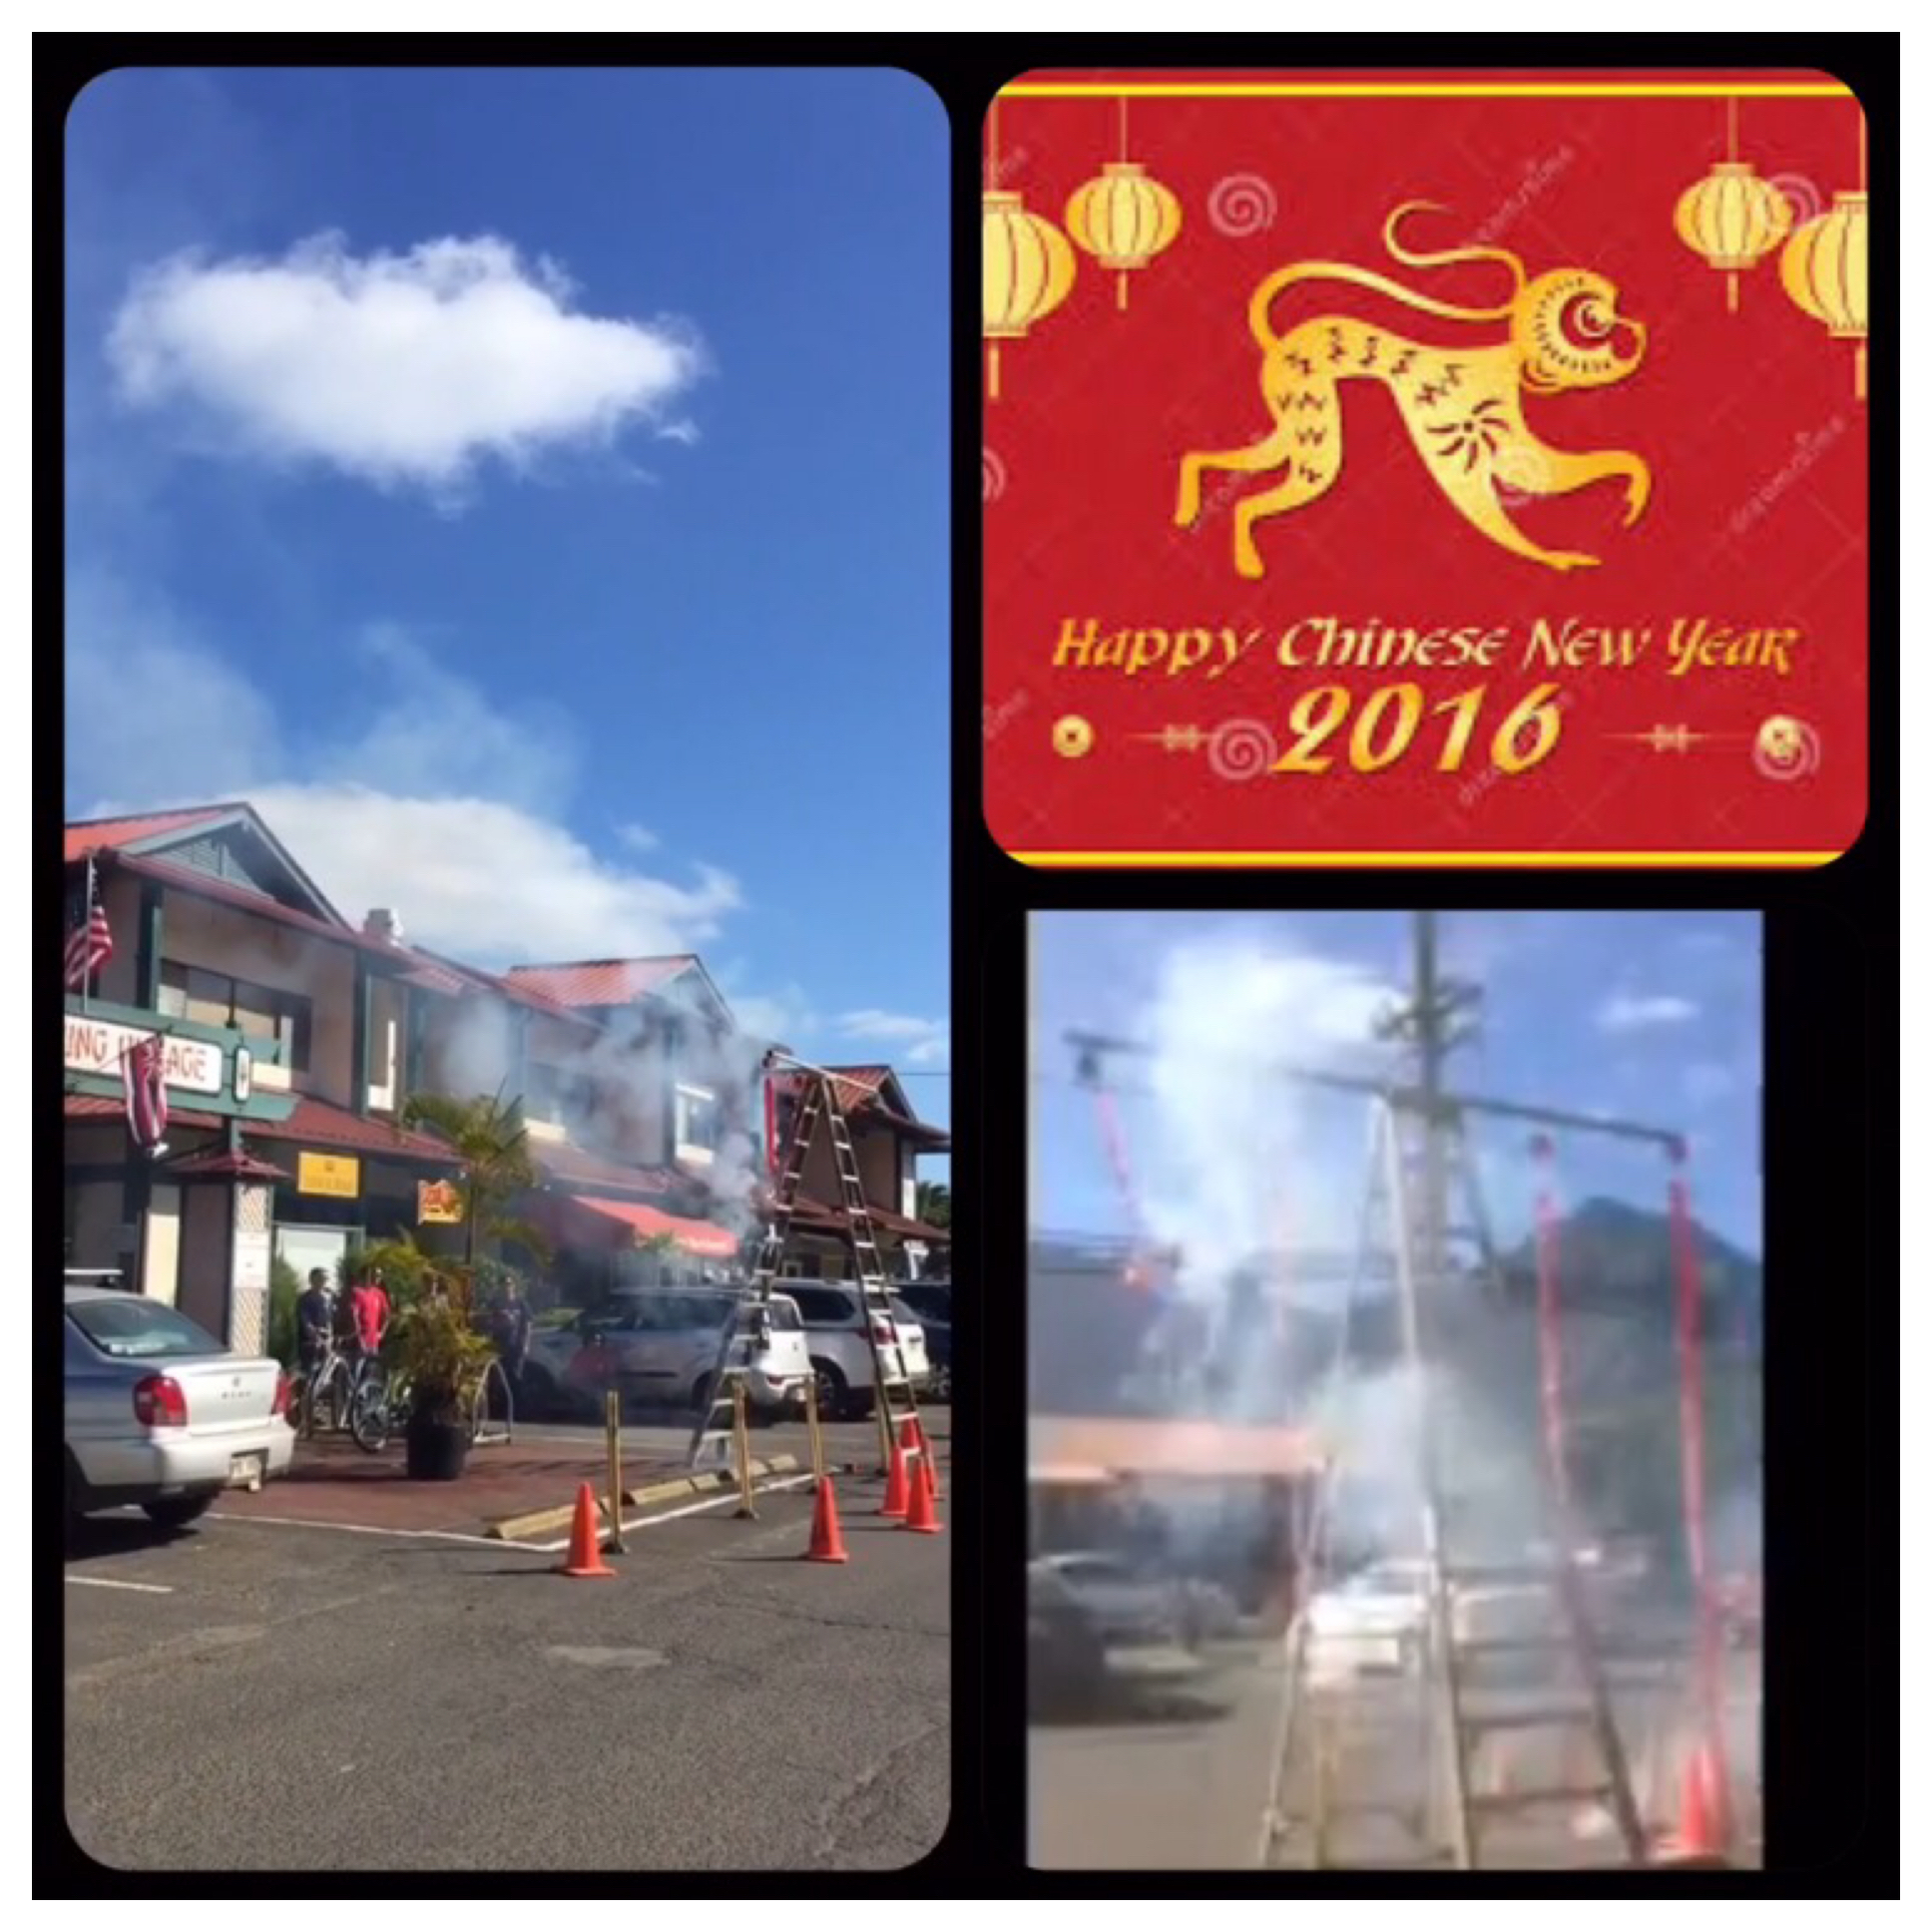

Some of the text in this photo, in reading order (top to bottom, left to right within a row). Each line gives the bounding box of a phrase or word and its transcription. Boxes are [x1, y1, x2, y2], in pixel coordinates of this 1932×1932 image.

[1053, 616, 1798, 679] Happy Chinese New Year
[1271, 682, 1564, 775] 2016
